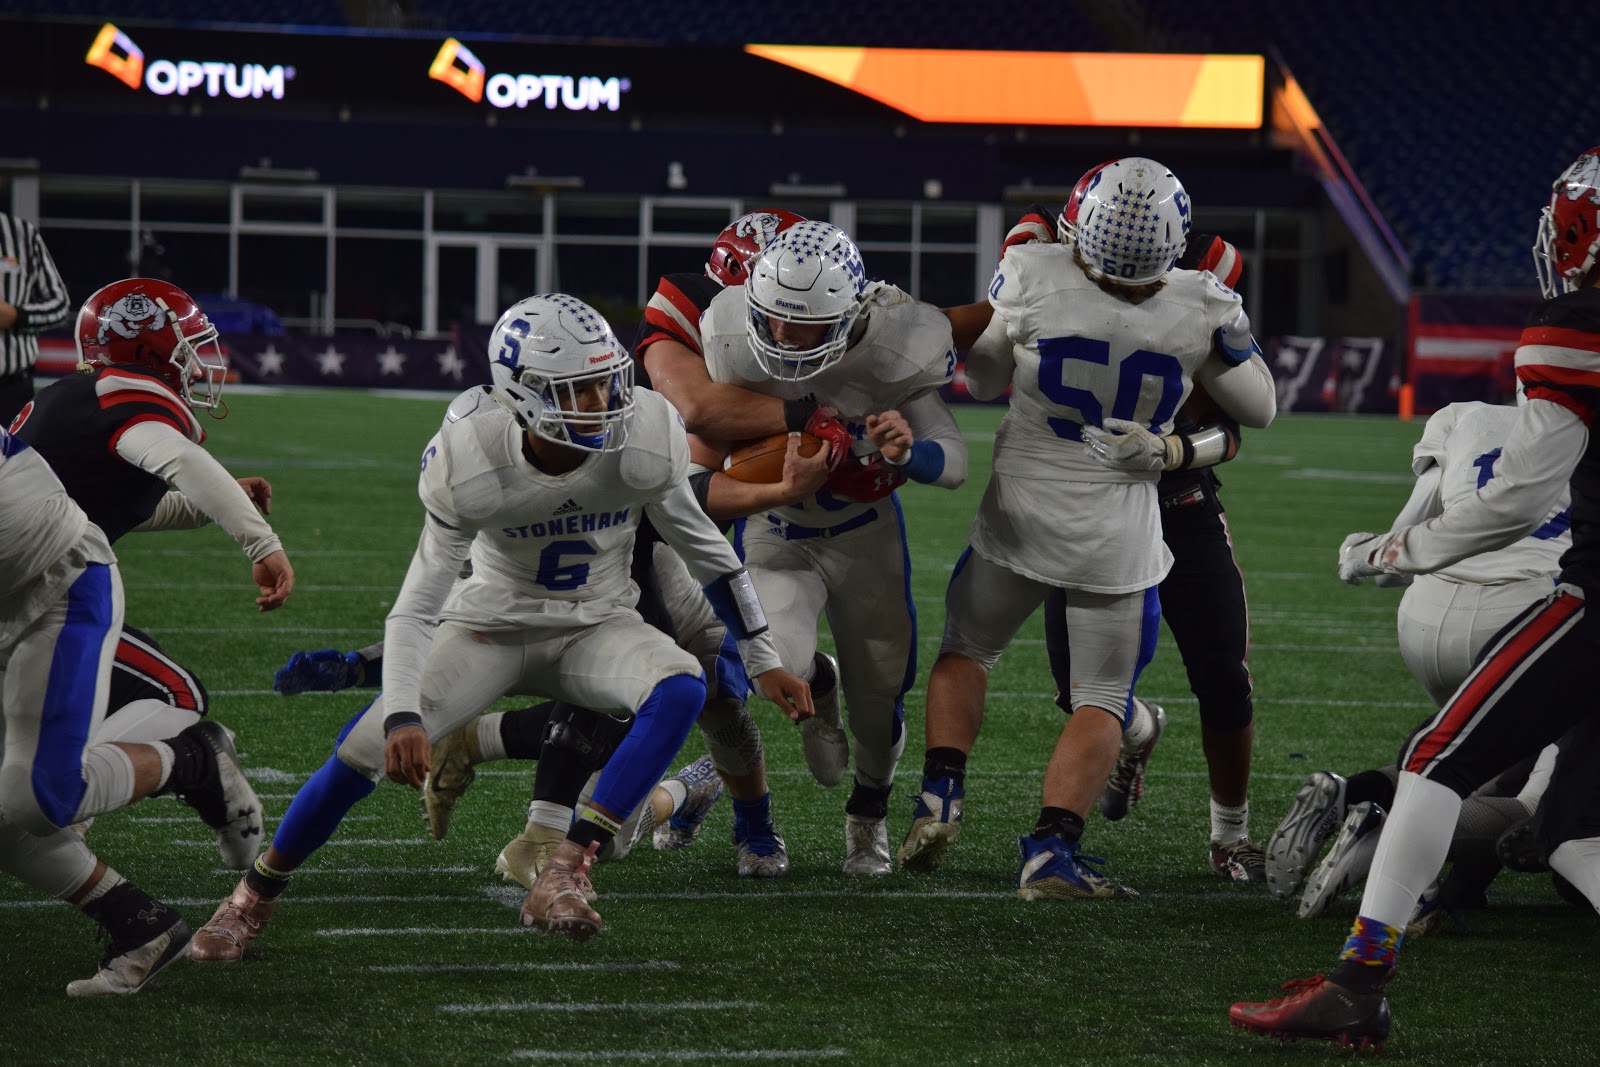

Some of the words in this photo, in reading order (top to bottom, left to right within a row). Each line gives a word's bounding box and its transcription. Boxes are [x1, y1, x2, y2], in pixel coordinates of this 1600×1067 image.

[145, 58, 286, 101] OPTUM
[485, 73, 621, 112] OPTUM
[1102, 257, 1137, 279] 50
[775, 299, 805, 311] SPARTANS
[499, 317, 531, 370] S
[589, 351, 615, 364] Riddell
[1037, 335, 1184, 442] 50
[502, 507, 631, 539] STONEHAM
[552, 503, 583, 516] adidas
[535, 539, 598, 592] 6
